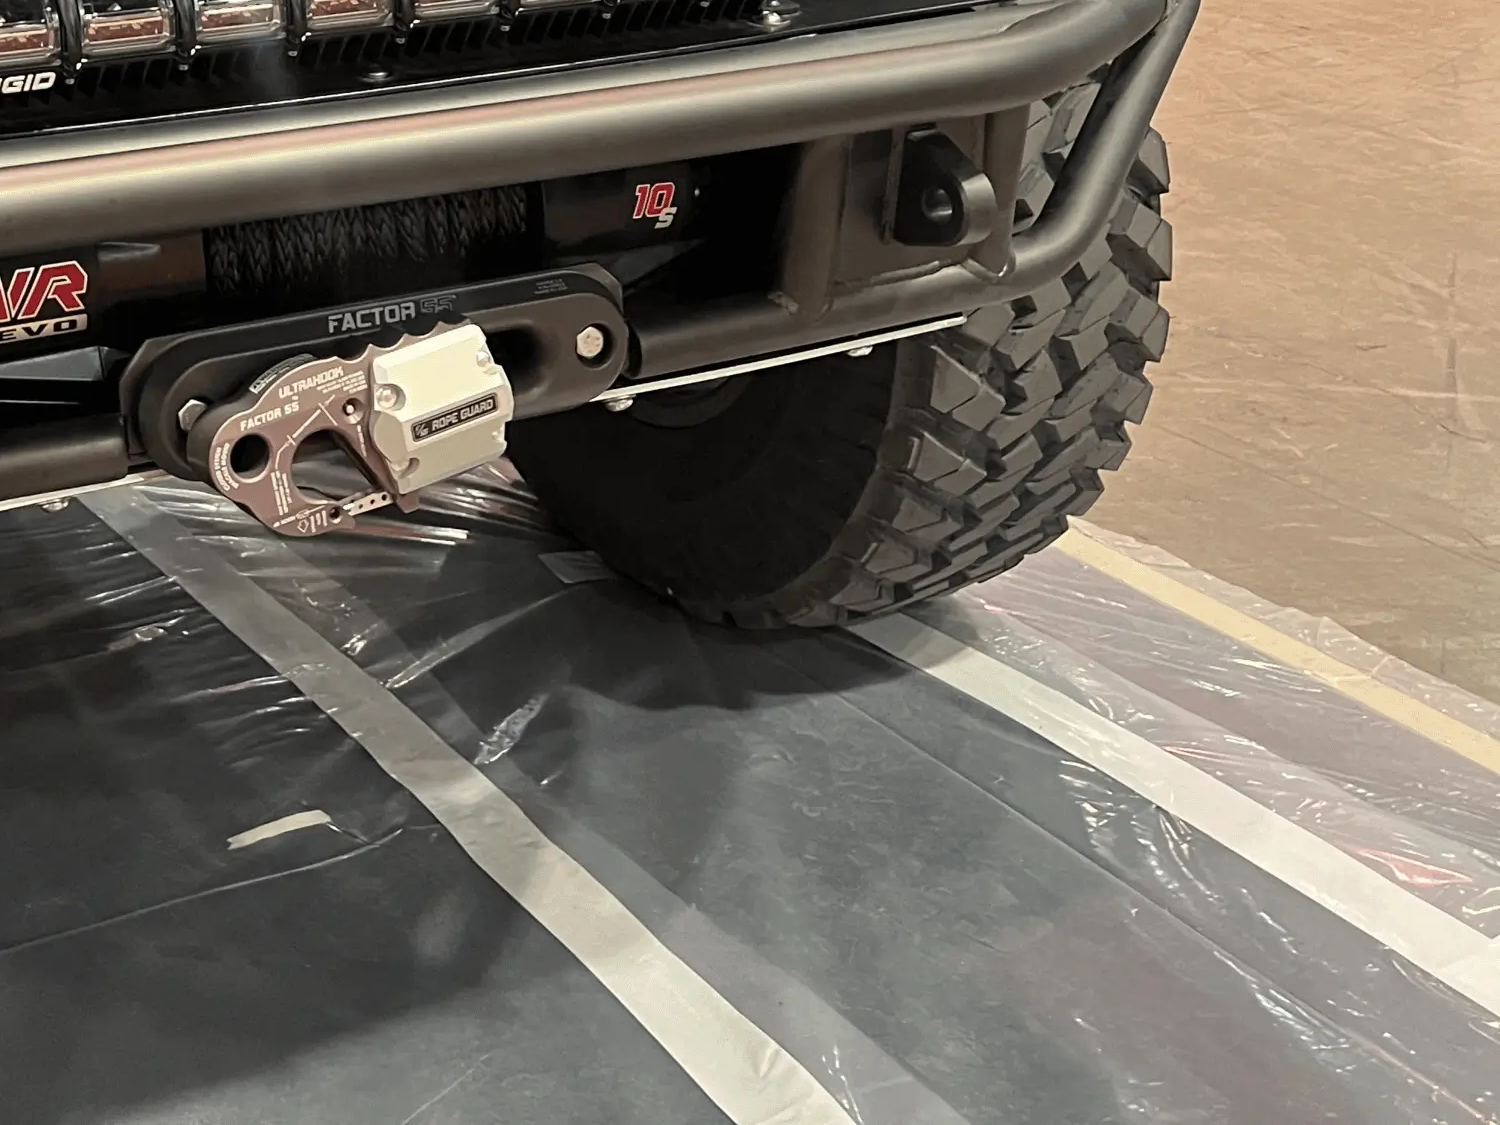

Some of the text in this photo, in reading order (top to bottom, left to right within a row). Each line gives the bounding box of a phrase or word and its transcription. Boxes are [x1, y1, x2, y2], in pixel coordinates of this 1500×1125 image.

[328, 302, 415, 333] FACTOR
[279, 366, 344, 399] ULTRAHOOK
[240, 408, 282, 431] FACTOR
[432, 412, 459, 432] ROPE
[460, 399, 494, 420] GUARD
